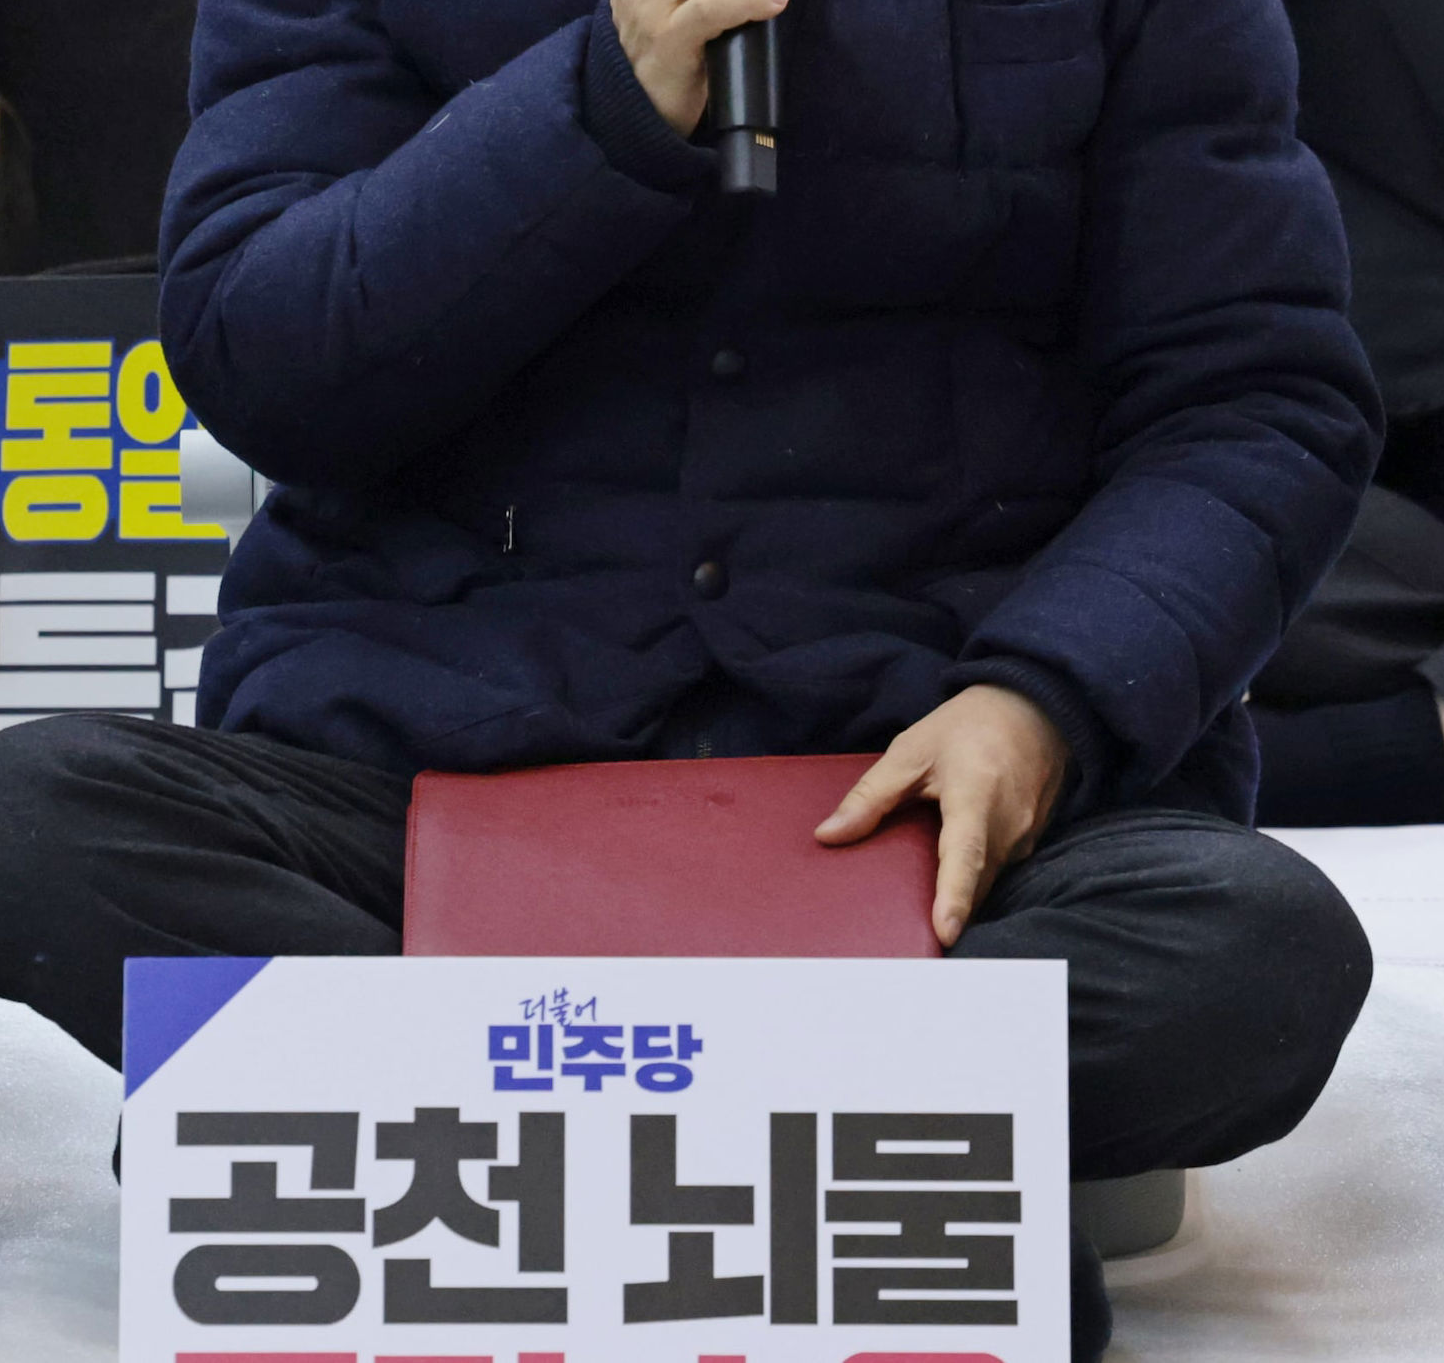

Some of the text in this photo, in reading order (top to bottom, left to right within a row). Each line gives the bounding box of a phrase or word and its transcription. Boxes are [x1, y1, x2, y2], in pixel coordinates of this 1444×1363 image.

[518, 987, 597, 1028] 더불어
[488, 1024, 702, 1092] 민주당
[169, 1107, 1021, 1325] 공천 뇌물
